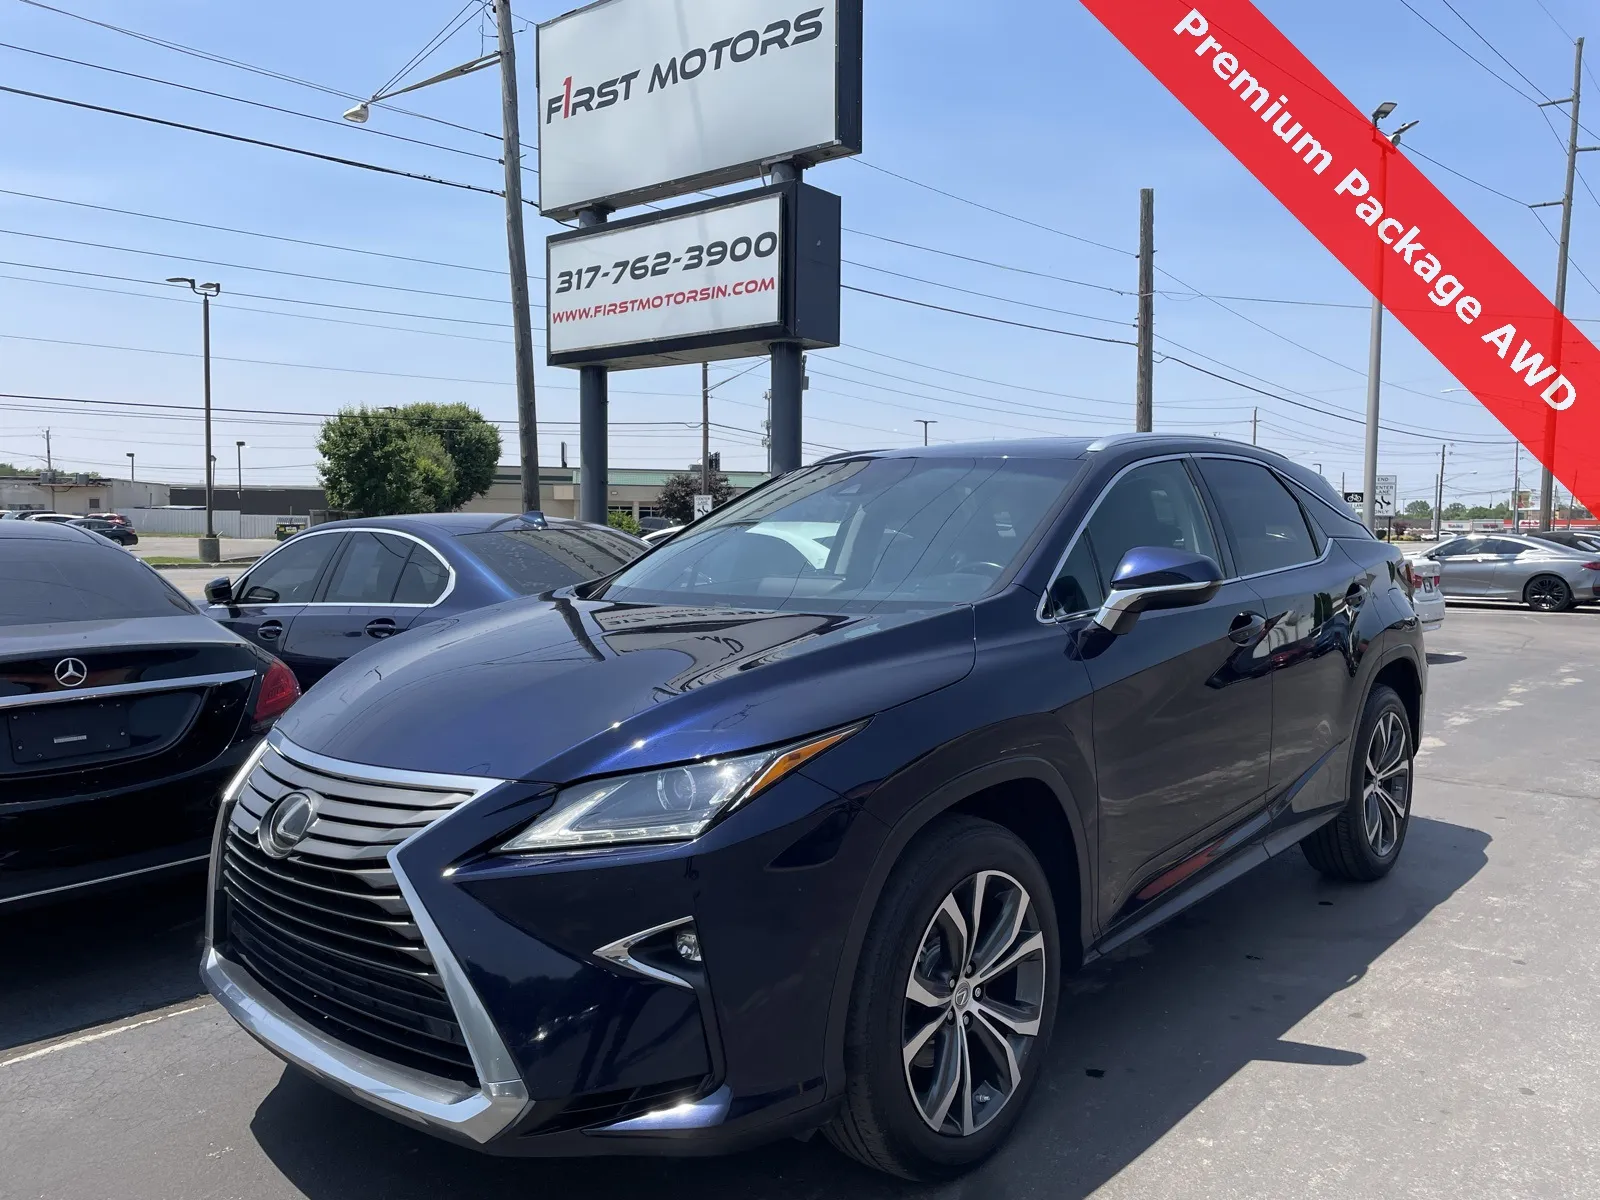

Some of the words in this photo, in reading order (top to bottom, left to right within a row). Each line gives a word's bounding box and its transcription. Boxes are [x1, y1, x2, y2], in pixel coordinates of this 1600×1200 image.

[647, 7, 825, 94] MOTORS
[554, 230, 779, 295] 317-762-3900
[551, 276, 776, 325] WWW.FIRSTMOTORSIN.COM
